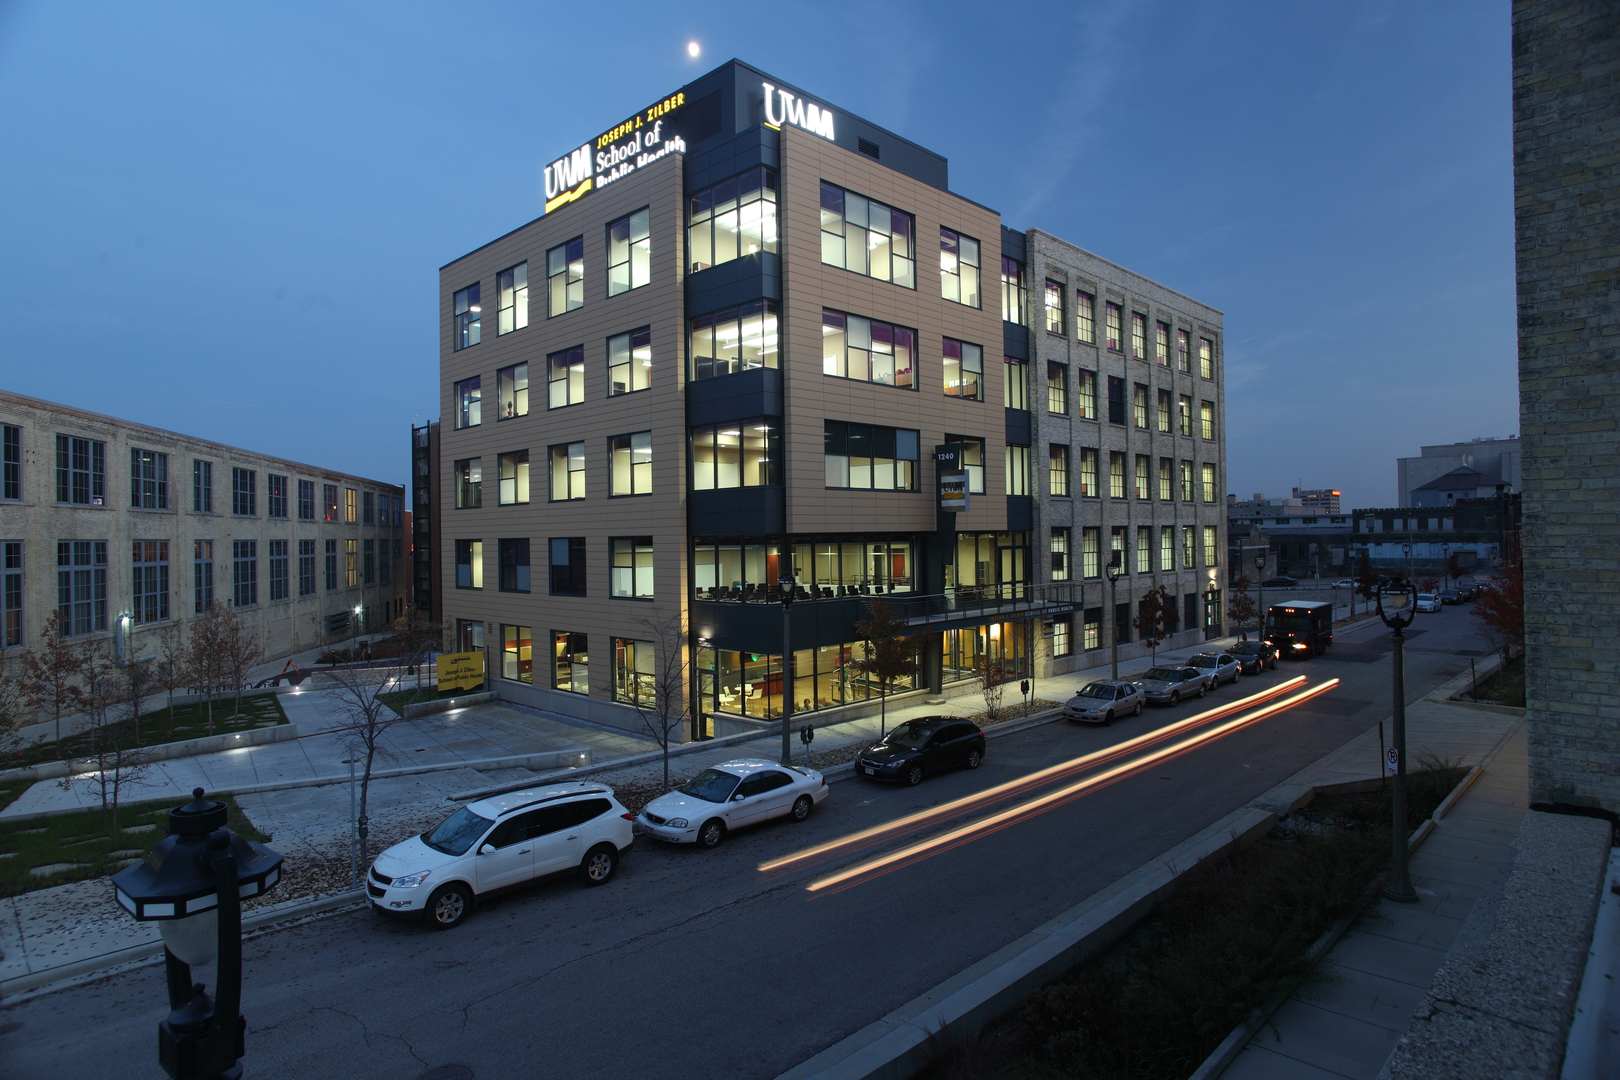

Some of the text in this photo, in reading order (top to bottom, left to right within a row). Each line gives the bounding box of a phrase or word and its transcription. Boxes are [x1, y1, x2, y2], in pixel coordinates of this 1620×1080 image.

[597, 92, 685, 149] JOSEPH J. ZILBER
[763, 82, 835, 140] UWM
[544, 144, 592, 199] UWM
[596, 120, 663, 172] School of
